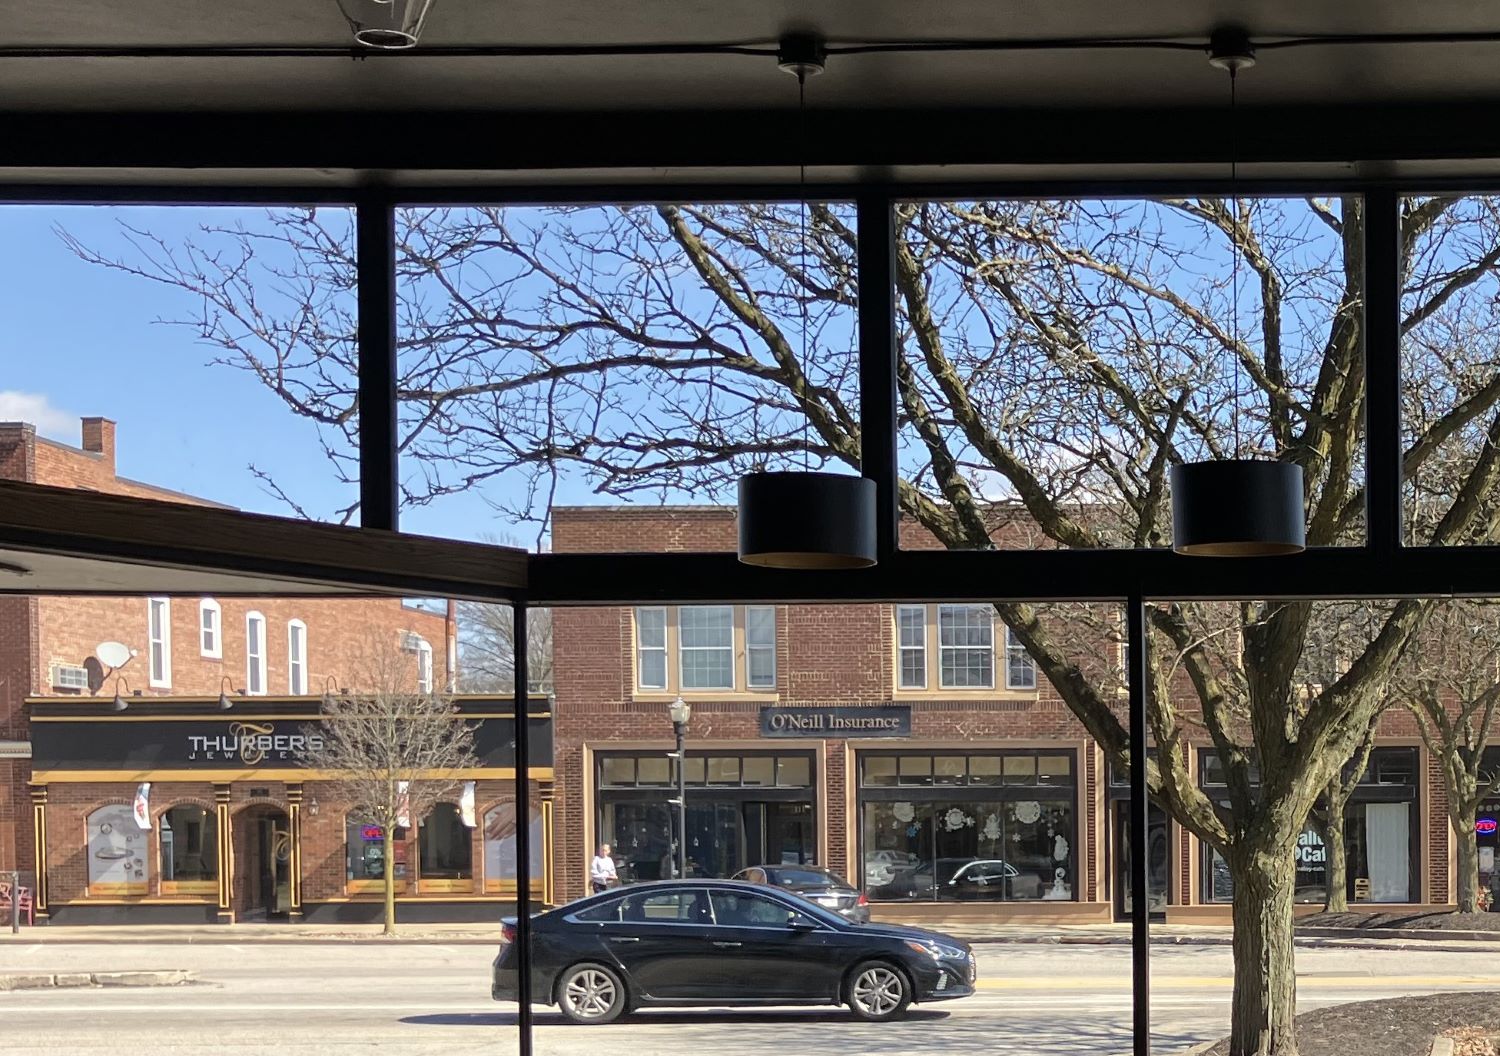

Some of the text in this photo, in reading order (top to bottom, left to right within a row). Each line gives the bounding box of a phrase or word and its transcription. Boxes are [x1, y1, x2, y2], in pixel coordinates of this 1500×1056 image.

[771, 714, 900, 729] O'Neill Insurance
[188, 735, 324, 751] THURBER'S
[188, 751, 308, 760] JEWELER
[1302, 846, 1326, 862] Caf
